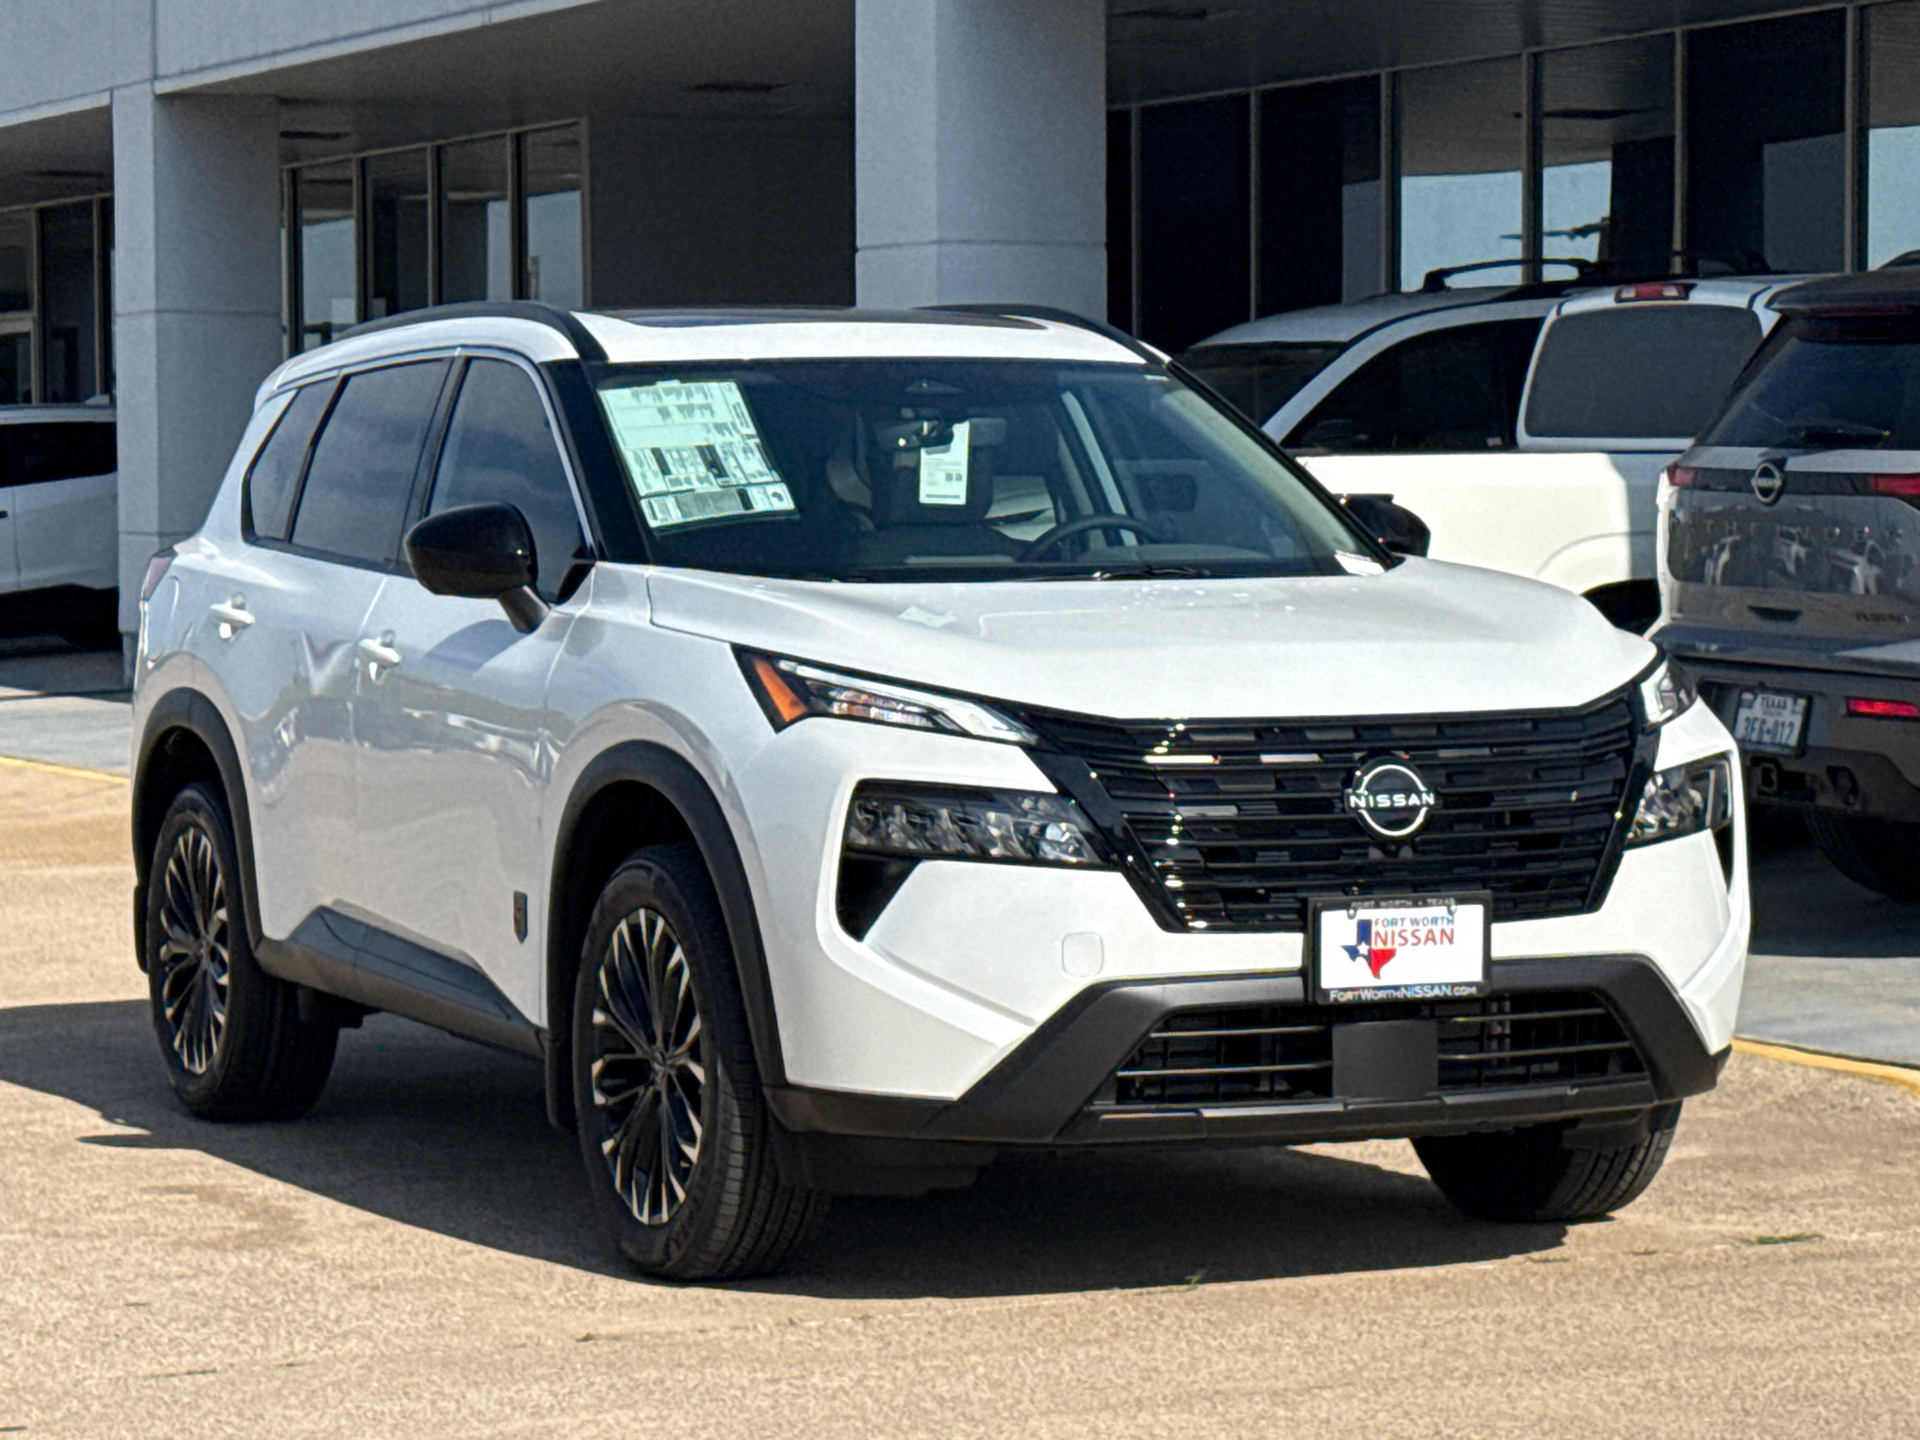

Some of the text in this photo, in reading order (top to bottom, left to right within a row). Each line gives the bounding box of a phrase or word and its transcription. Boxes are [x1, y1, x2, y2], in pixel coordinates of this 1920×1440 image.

[1349, 792, 1435, 808] NISSAN
[1350, 900, 1376, 909] FORT
[1379, 899, 1413, 908] WORTH
[1374, 915, 1455, 928] FORT WORTH
[1374, 927, 1455, 947] NISSAN
